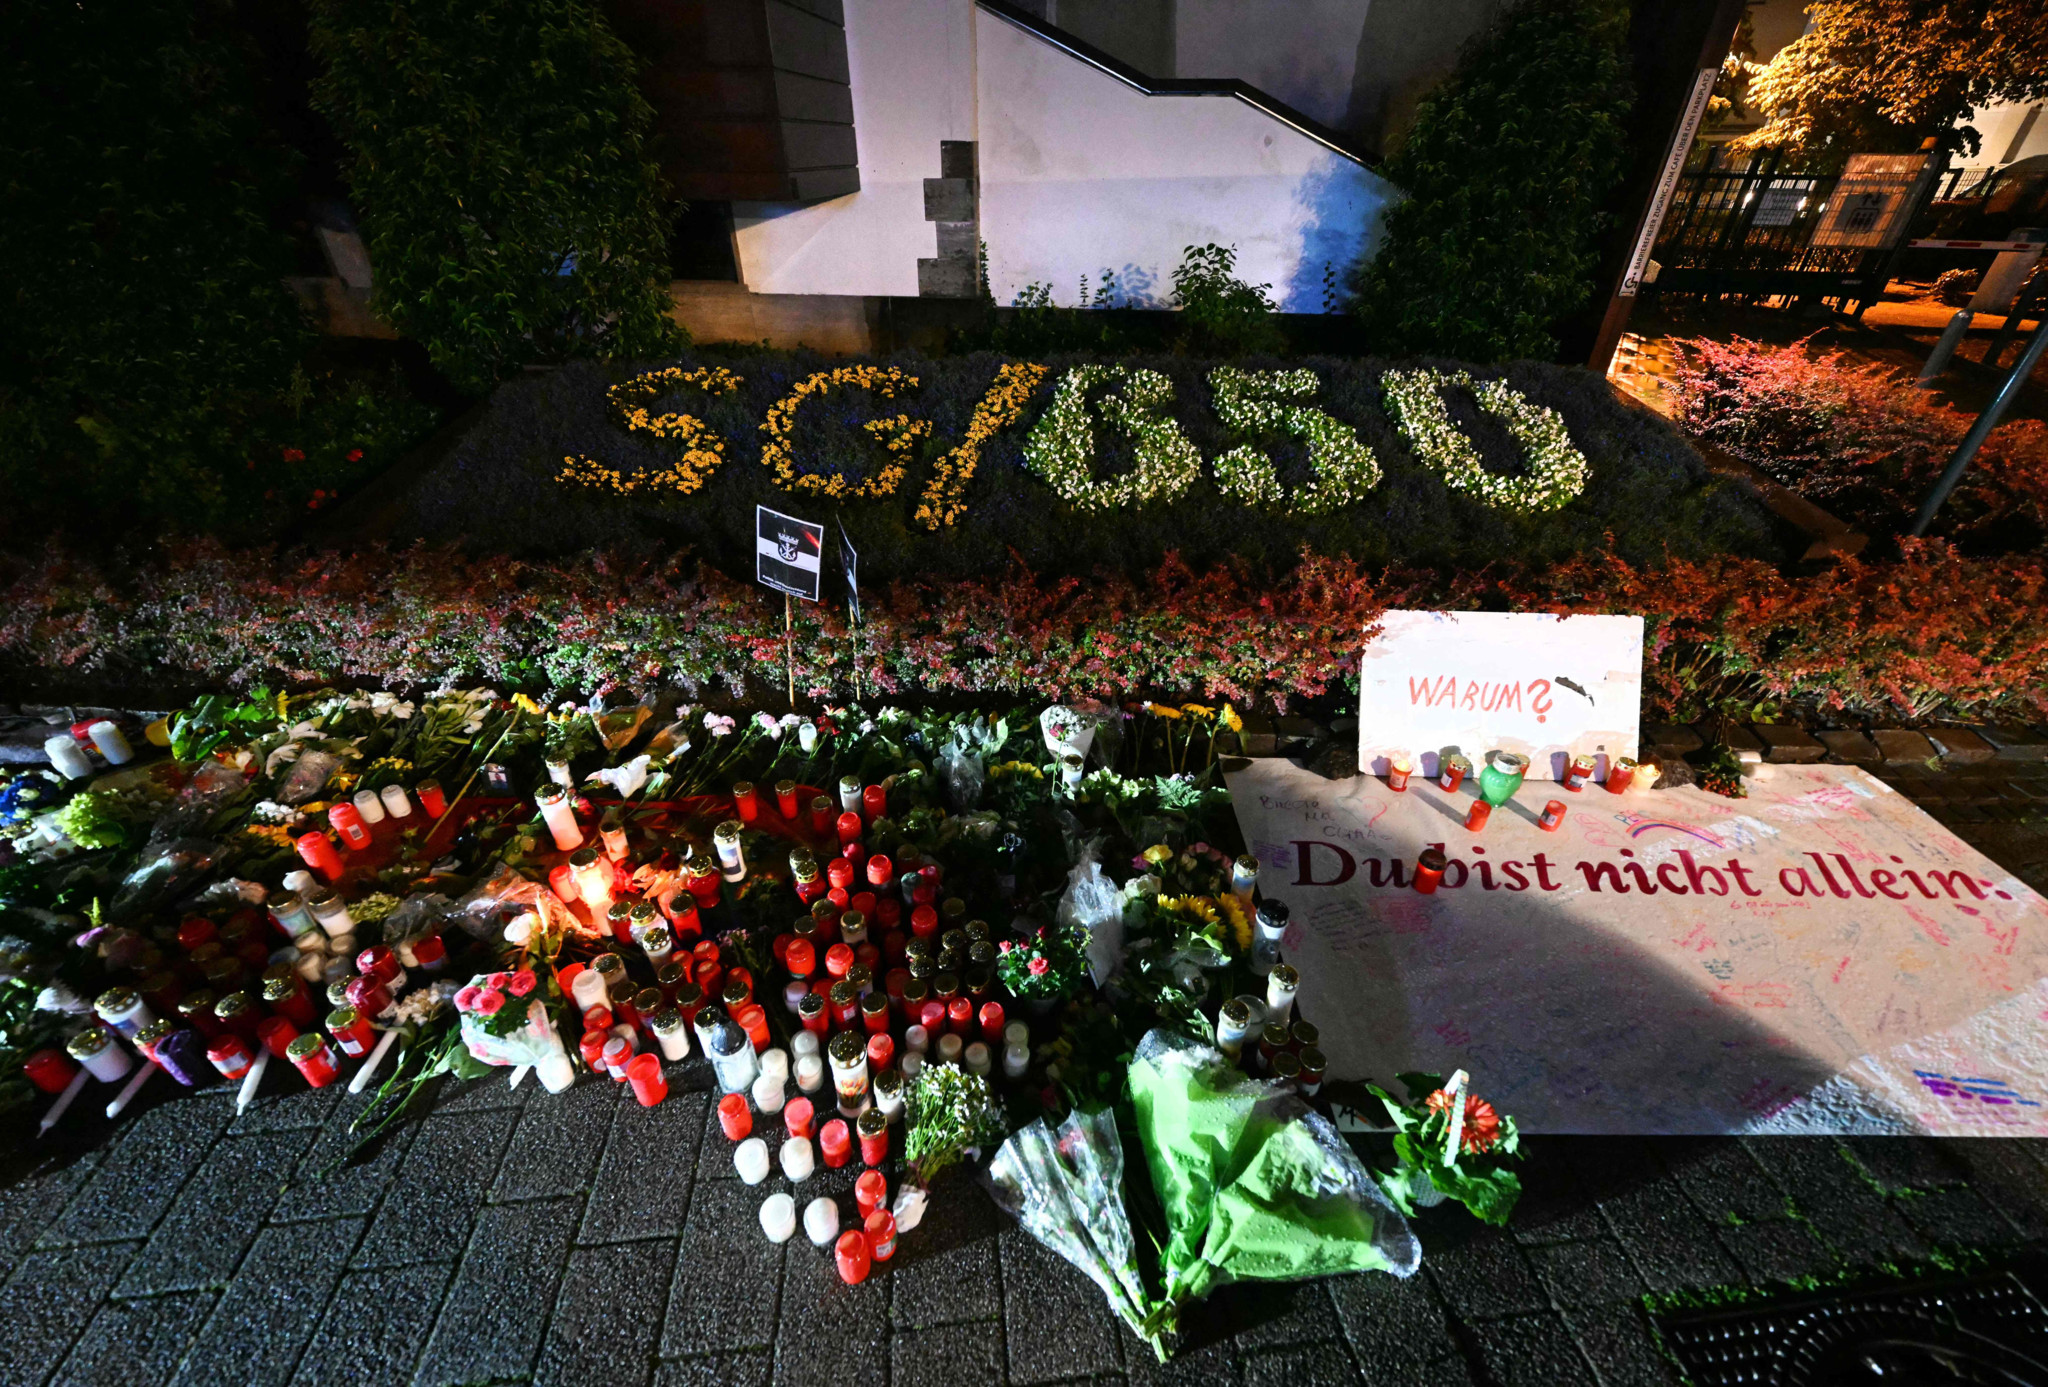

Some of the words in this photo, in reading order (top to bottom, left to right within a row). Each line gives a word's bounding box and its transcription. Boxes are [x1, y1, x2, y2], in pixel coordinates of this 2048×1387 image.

[1634, 220, 1657, 270] BARRIEREFREIER
[1653, 188, 1669, 218] ZUGANG
[1664, 171, 1675, 188] ZUM
[1685, 115, 1696, 132] DEN
[1692, 72, 1712, 114] PARKPLATZ
[1408, 674, 1553, 724] WARUM?
[1289, 840, 1412, 889] Du
[1575, 848, 1762, 897] nicht
